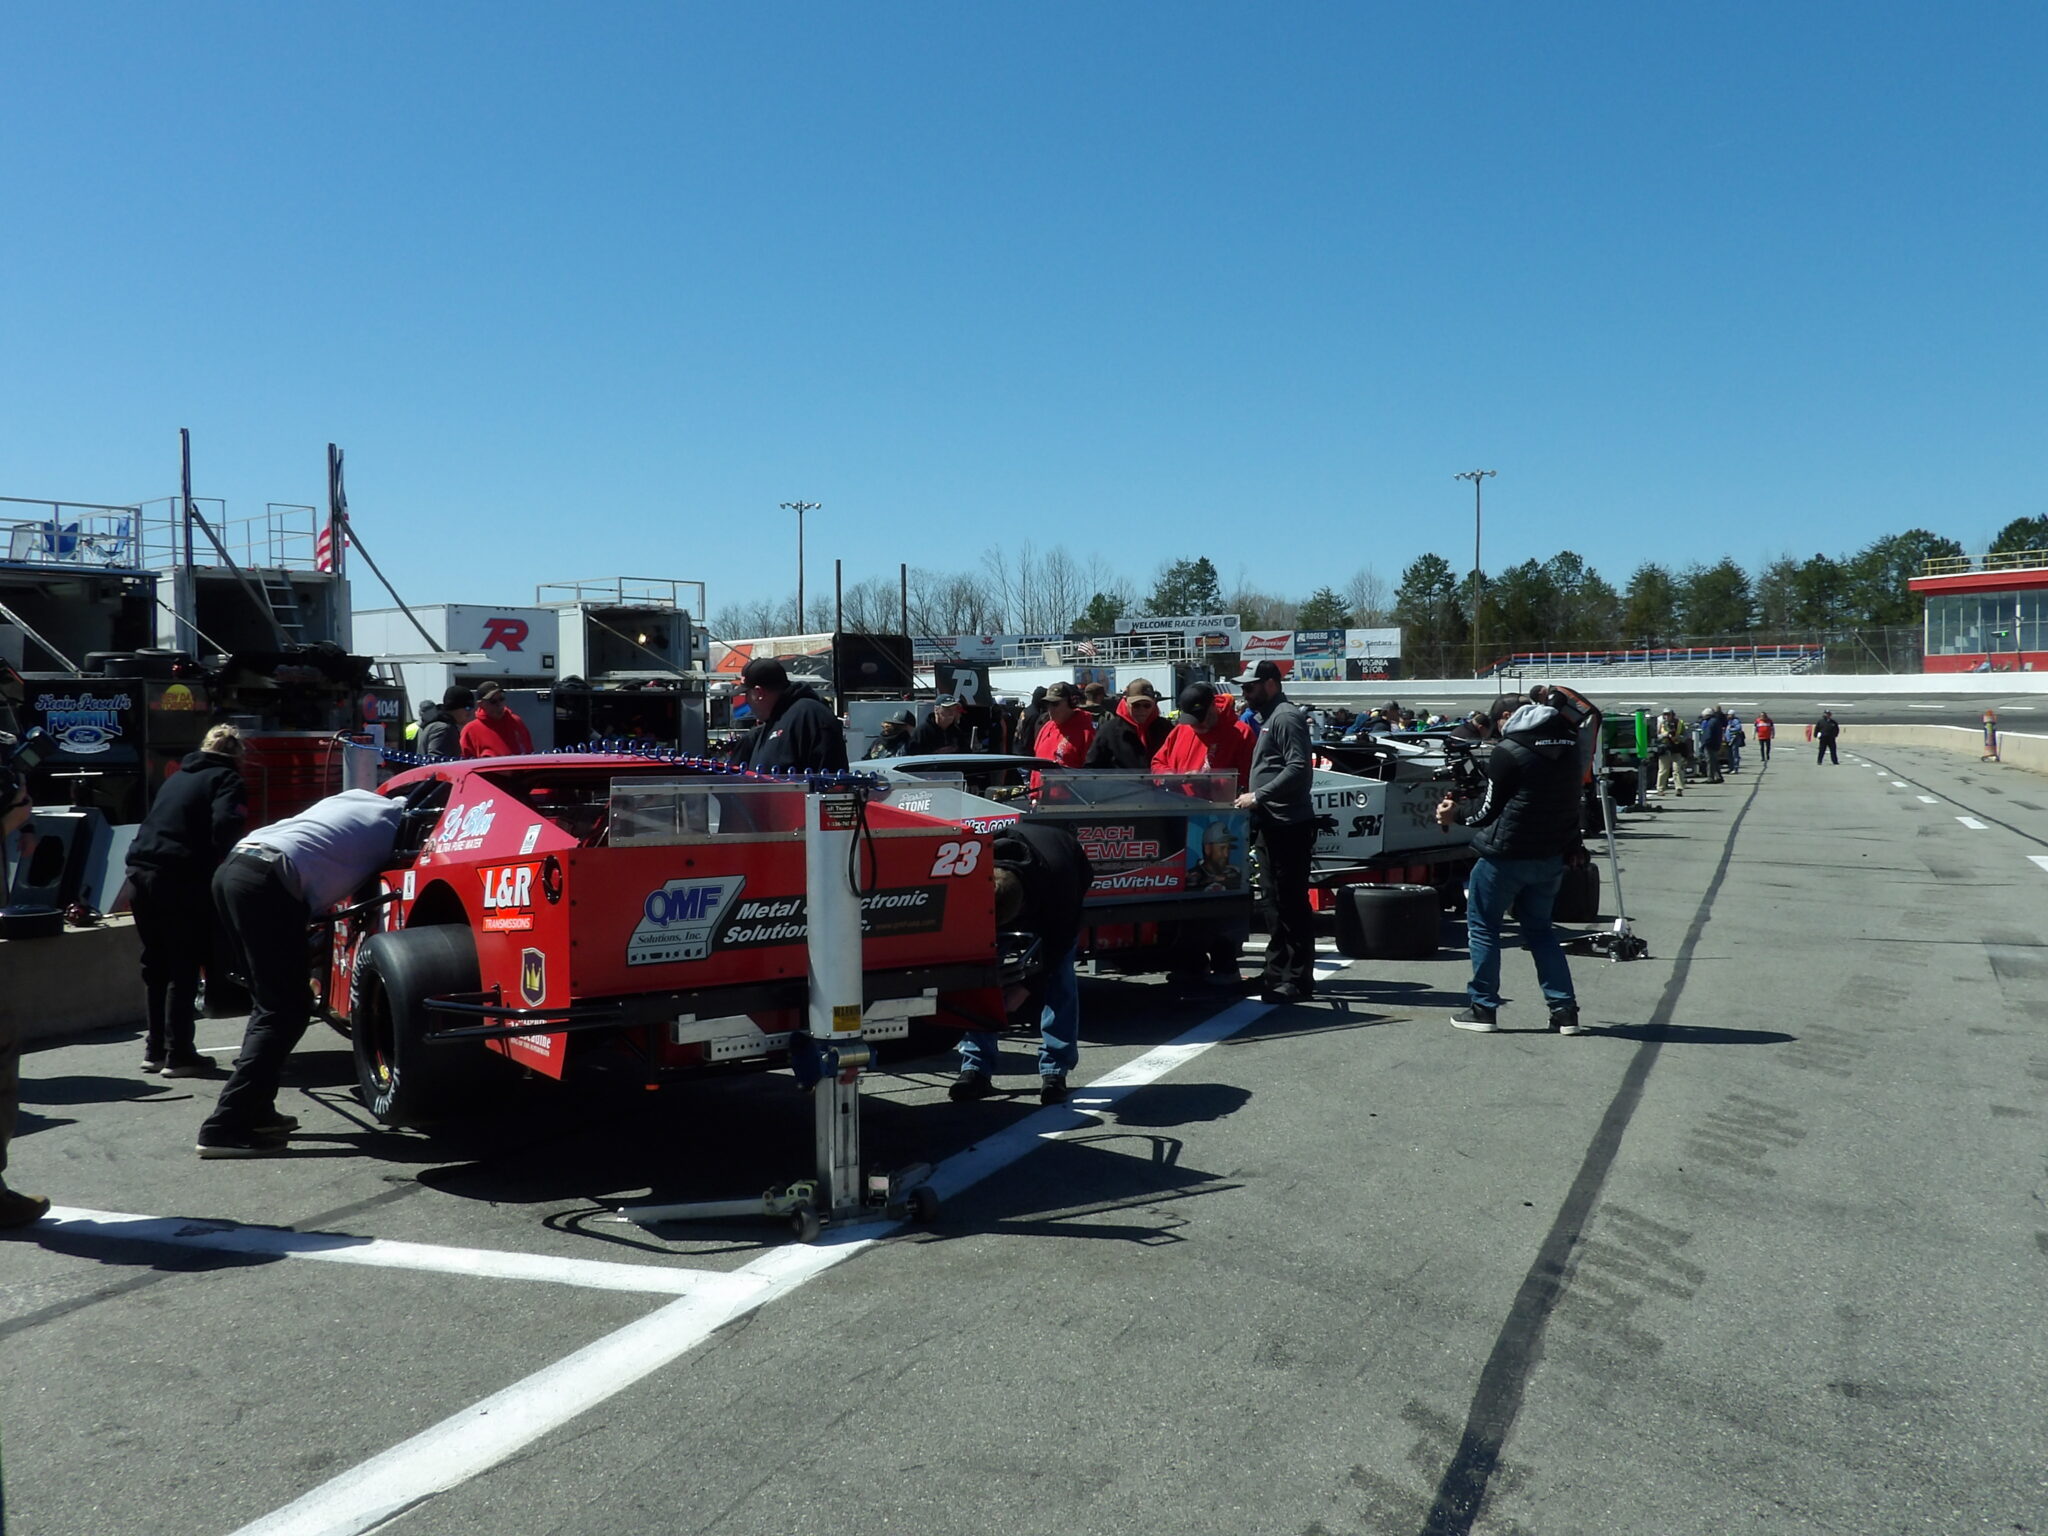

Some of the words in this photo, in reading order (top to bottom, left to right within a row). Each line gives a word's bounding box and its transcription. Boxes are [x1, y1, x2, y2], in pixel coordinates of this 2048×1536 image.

[1132, 620, 1173, 630] WELCOME
[1174, 619, 1196, 628] RACE
[1197, 618, 1222, 627] FANS!
[1248, 638, 1287, 647] Budweiser
[1306, 632, 1328, 640] ROGERS
[36, 695, 76, 711] Kevin
[77, 694, 131, 711] Powell's
[376, 700, 399, 716] 1041
[47, 711, 122, 736] FOOTHILL
[73, 731, 95, 742] Ford
[898, 799, 931, 812] STONE
[1313, 791, 1357, 809] TEIN
[1078, 826, 1134, 841] ZACH
[1083, 841, 1159, 860] EWER
[930, 840, 982, 878] 23
[483, 867, 532, 908] L&R
[1091, 875, 1178, 889] ceWithUs
[645, 886, 722, 926] QMF
[736, 899, 800, 920] Metal
[861, 890, 929, 910] ctronic
[485, 917, 530, 929] TRANSMISSIONS
[636, 934, 682, 944] Solutions,
[684, 931, 702, 940] Inc.
[723, 925, 808, 943] Solution
